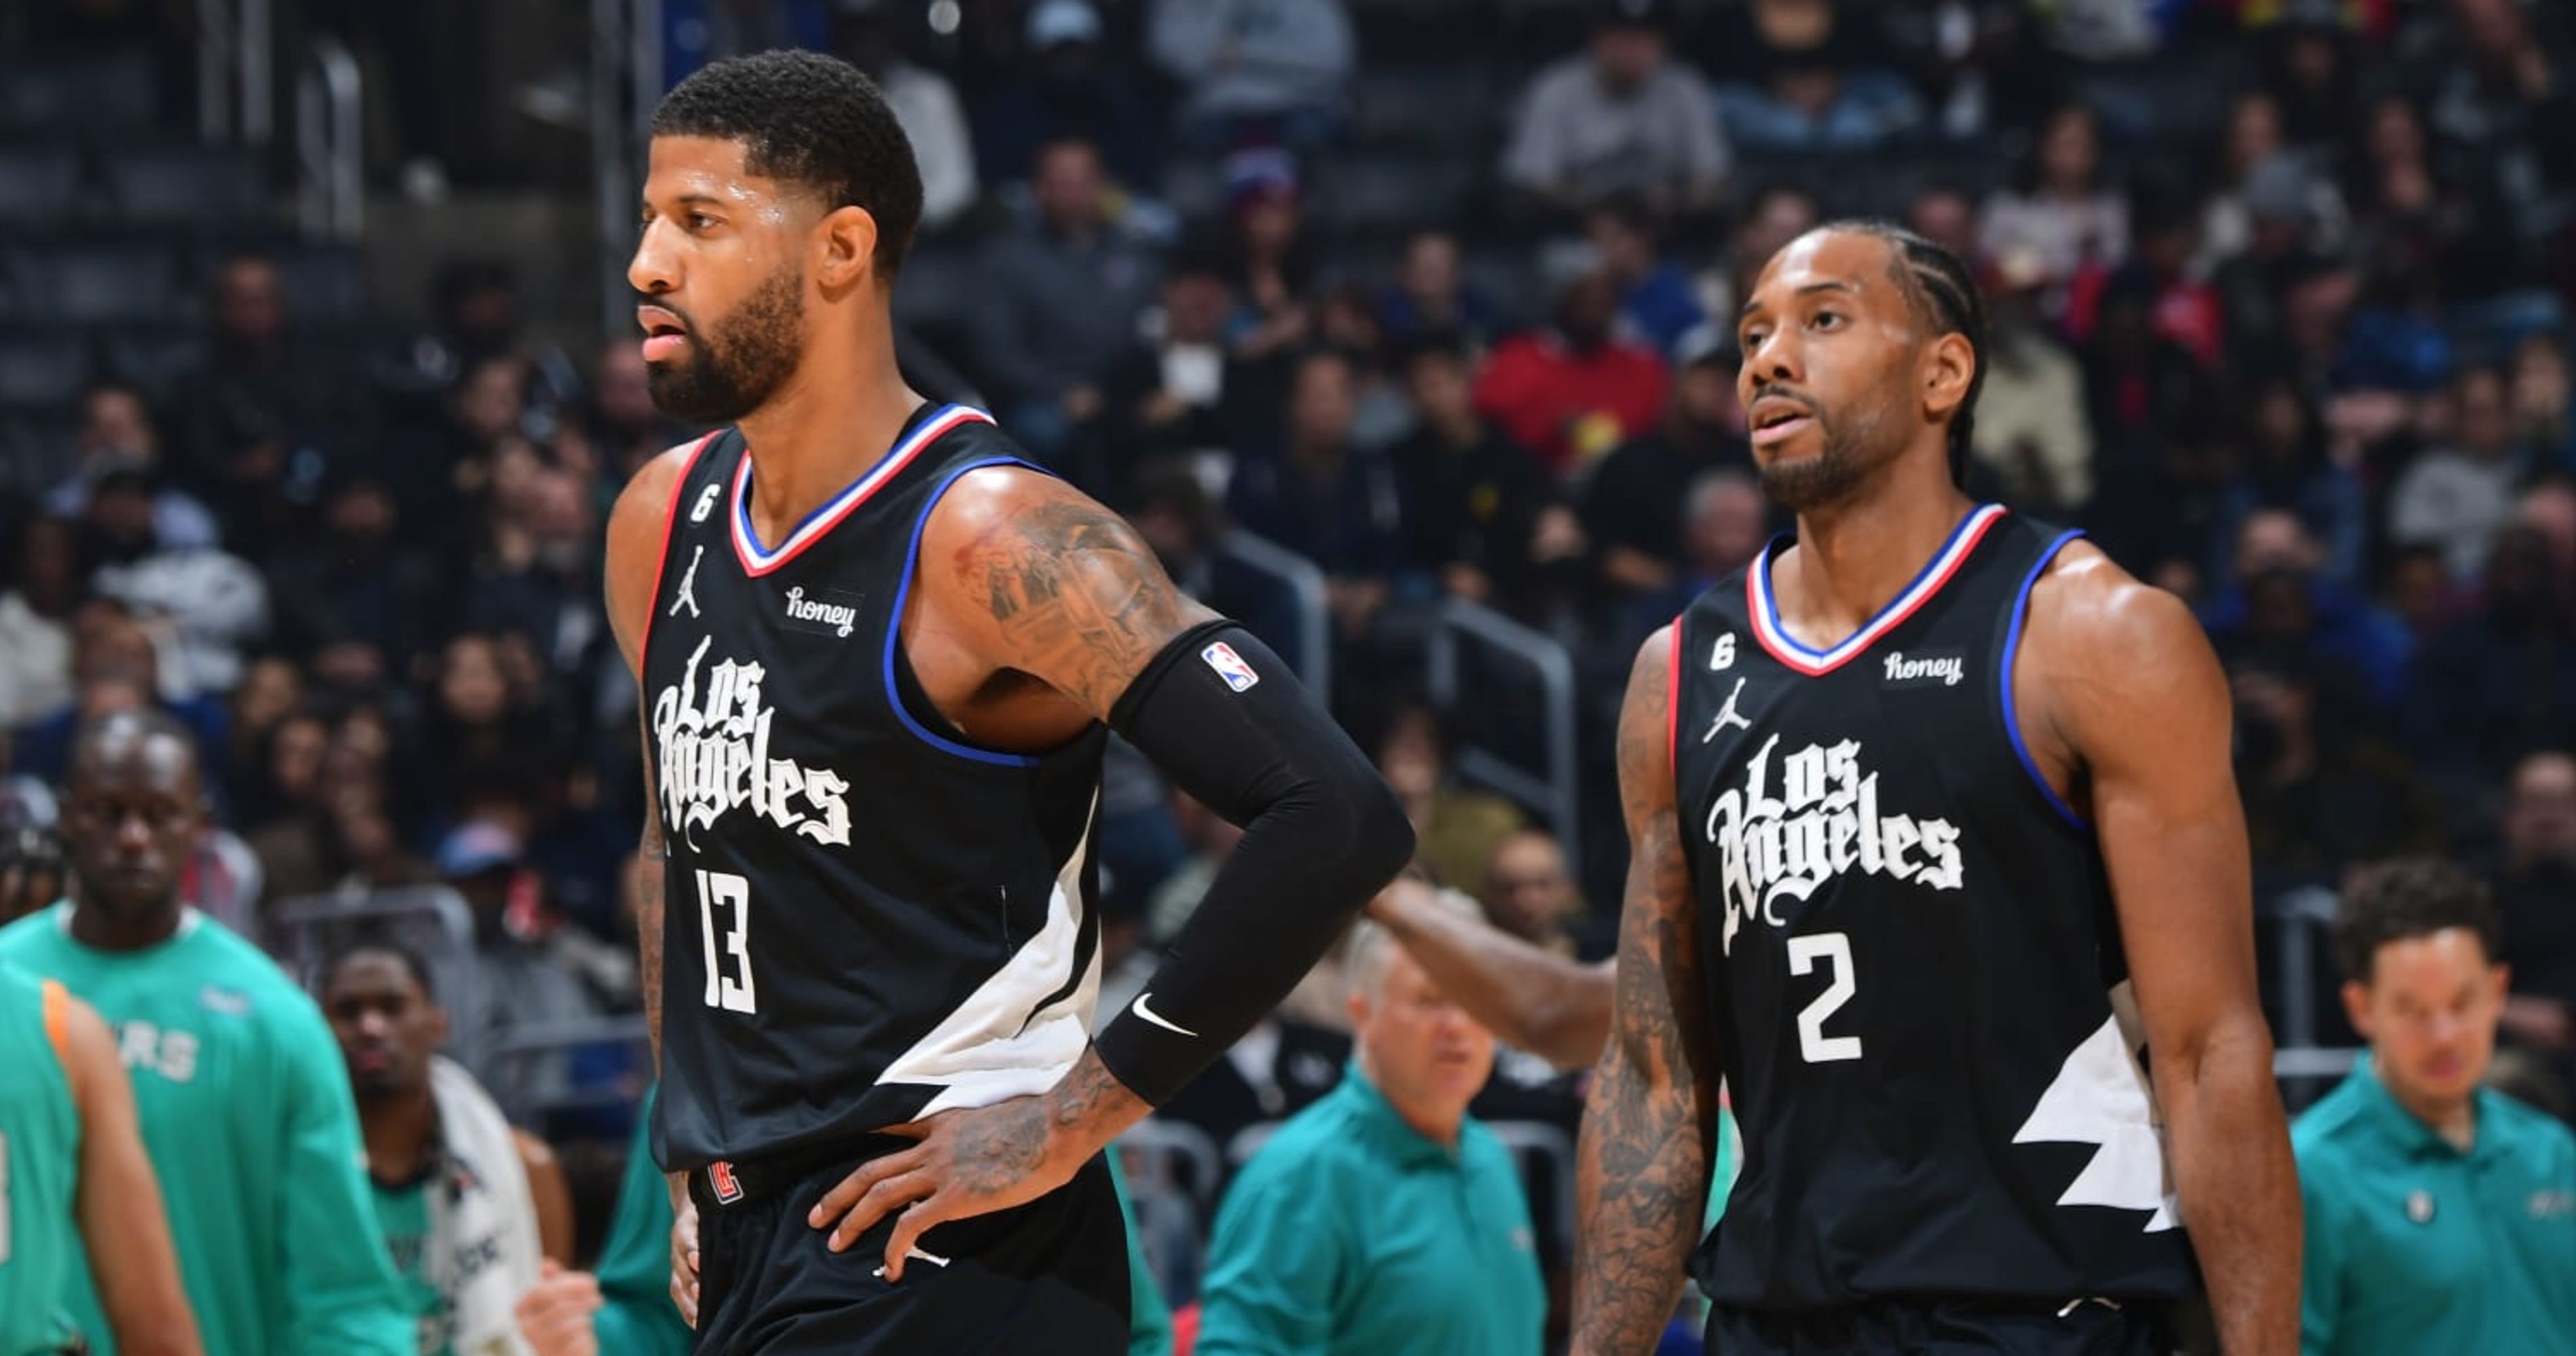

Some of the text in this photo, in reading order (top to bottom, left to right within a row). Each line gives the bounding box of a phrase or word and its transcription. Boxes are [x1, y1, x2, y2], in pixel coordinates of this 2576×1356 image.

[690, 483, 721, 522] 6
[786, 586, 856, 637] honey
[1710, 633, 1735, 671] 6
[673, 635, 765, 738] Los
[1884, 652, 1963, 685] honey
[653, 685, 851, 857] Angeles
[1742, 733, 1861, 827] Los
[1706, 789, 1963, 957] Angeles
[696, 869, 756, 1014] 13
[1787, 932, 1862, 1062] 2
